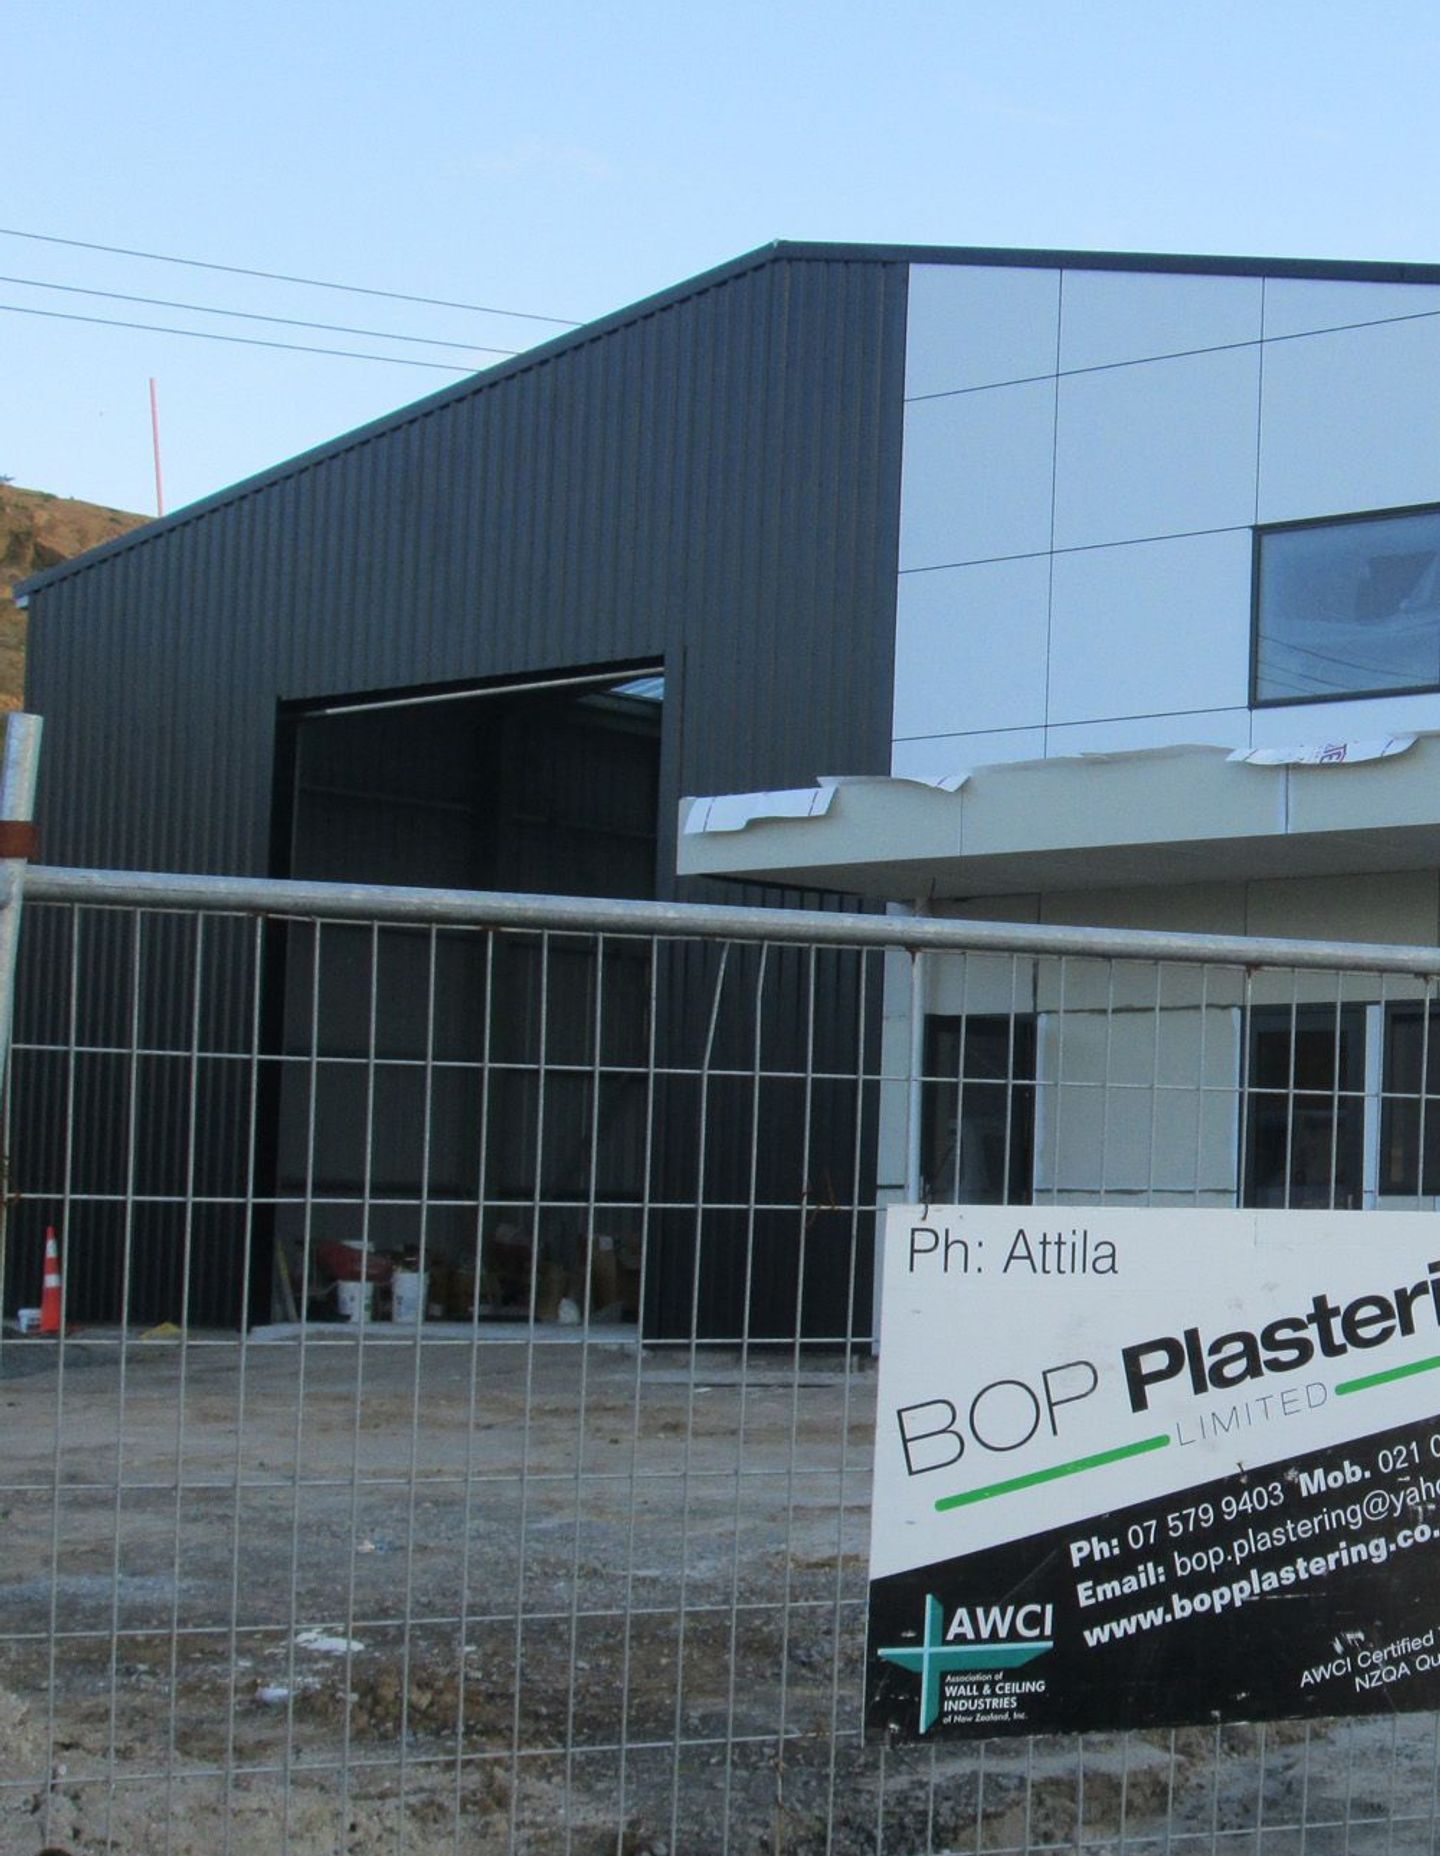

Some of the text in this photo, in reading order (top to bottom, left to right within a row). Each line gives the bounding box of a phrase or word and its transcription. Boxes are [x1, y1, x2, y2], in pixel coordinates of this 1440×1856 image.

[909, 1227, 1119, 1275] Ph: Attila
[896, 1360, 1098, 1476] BOP
[1175, 1381, 1328, 1446] LIMITED
[1069, 1536, 1120, 1568] Ph:
[1127, 1519, 1158, 1550] 07
[1167, 1503, 1214, 1538] 579
[1221, 1482, 1285, 1521] 9403
[1300, 1460, 1371, 1498] Mob.
[1378, 1441, 1420, 1474] 021
[1076, 1562, 1166, 1609] Email:
[945, 1604, 1053, 1641] AWCI
[945, 1671, 1004, 1683] Association of
[1300, 1657, 1352, 1689] AWCI
[1357, 1630, 1434, 1668] Certified
[1354, 1661, 1412, 1693] NZQA
[943, 1696, 1017, 1712] INDUSTRIES
[945, 1680, 1046, 1697] WALL & CEILING
[943, 1714, 953, 1724] of
[953, 1714, 974, 1724] New
